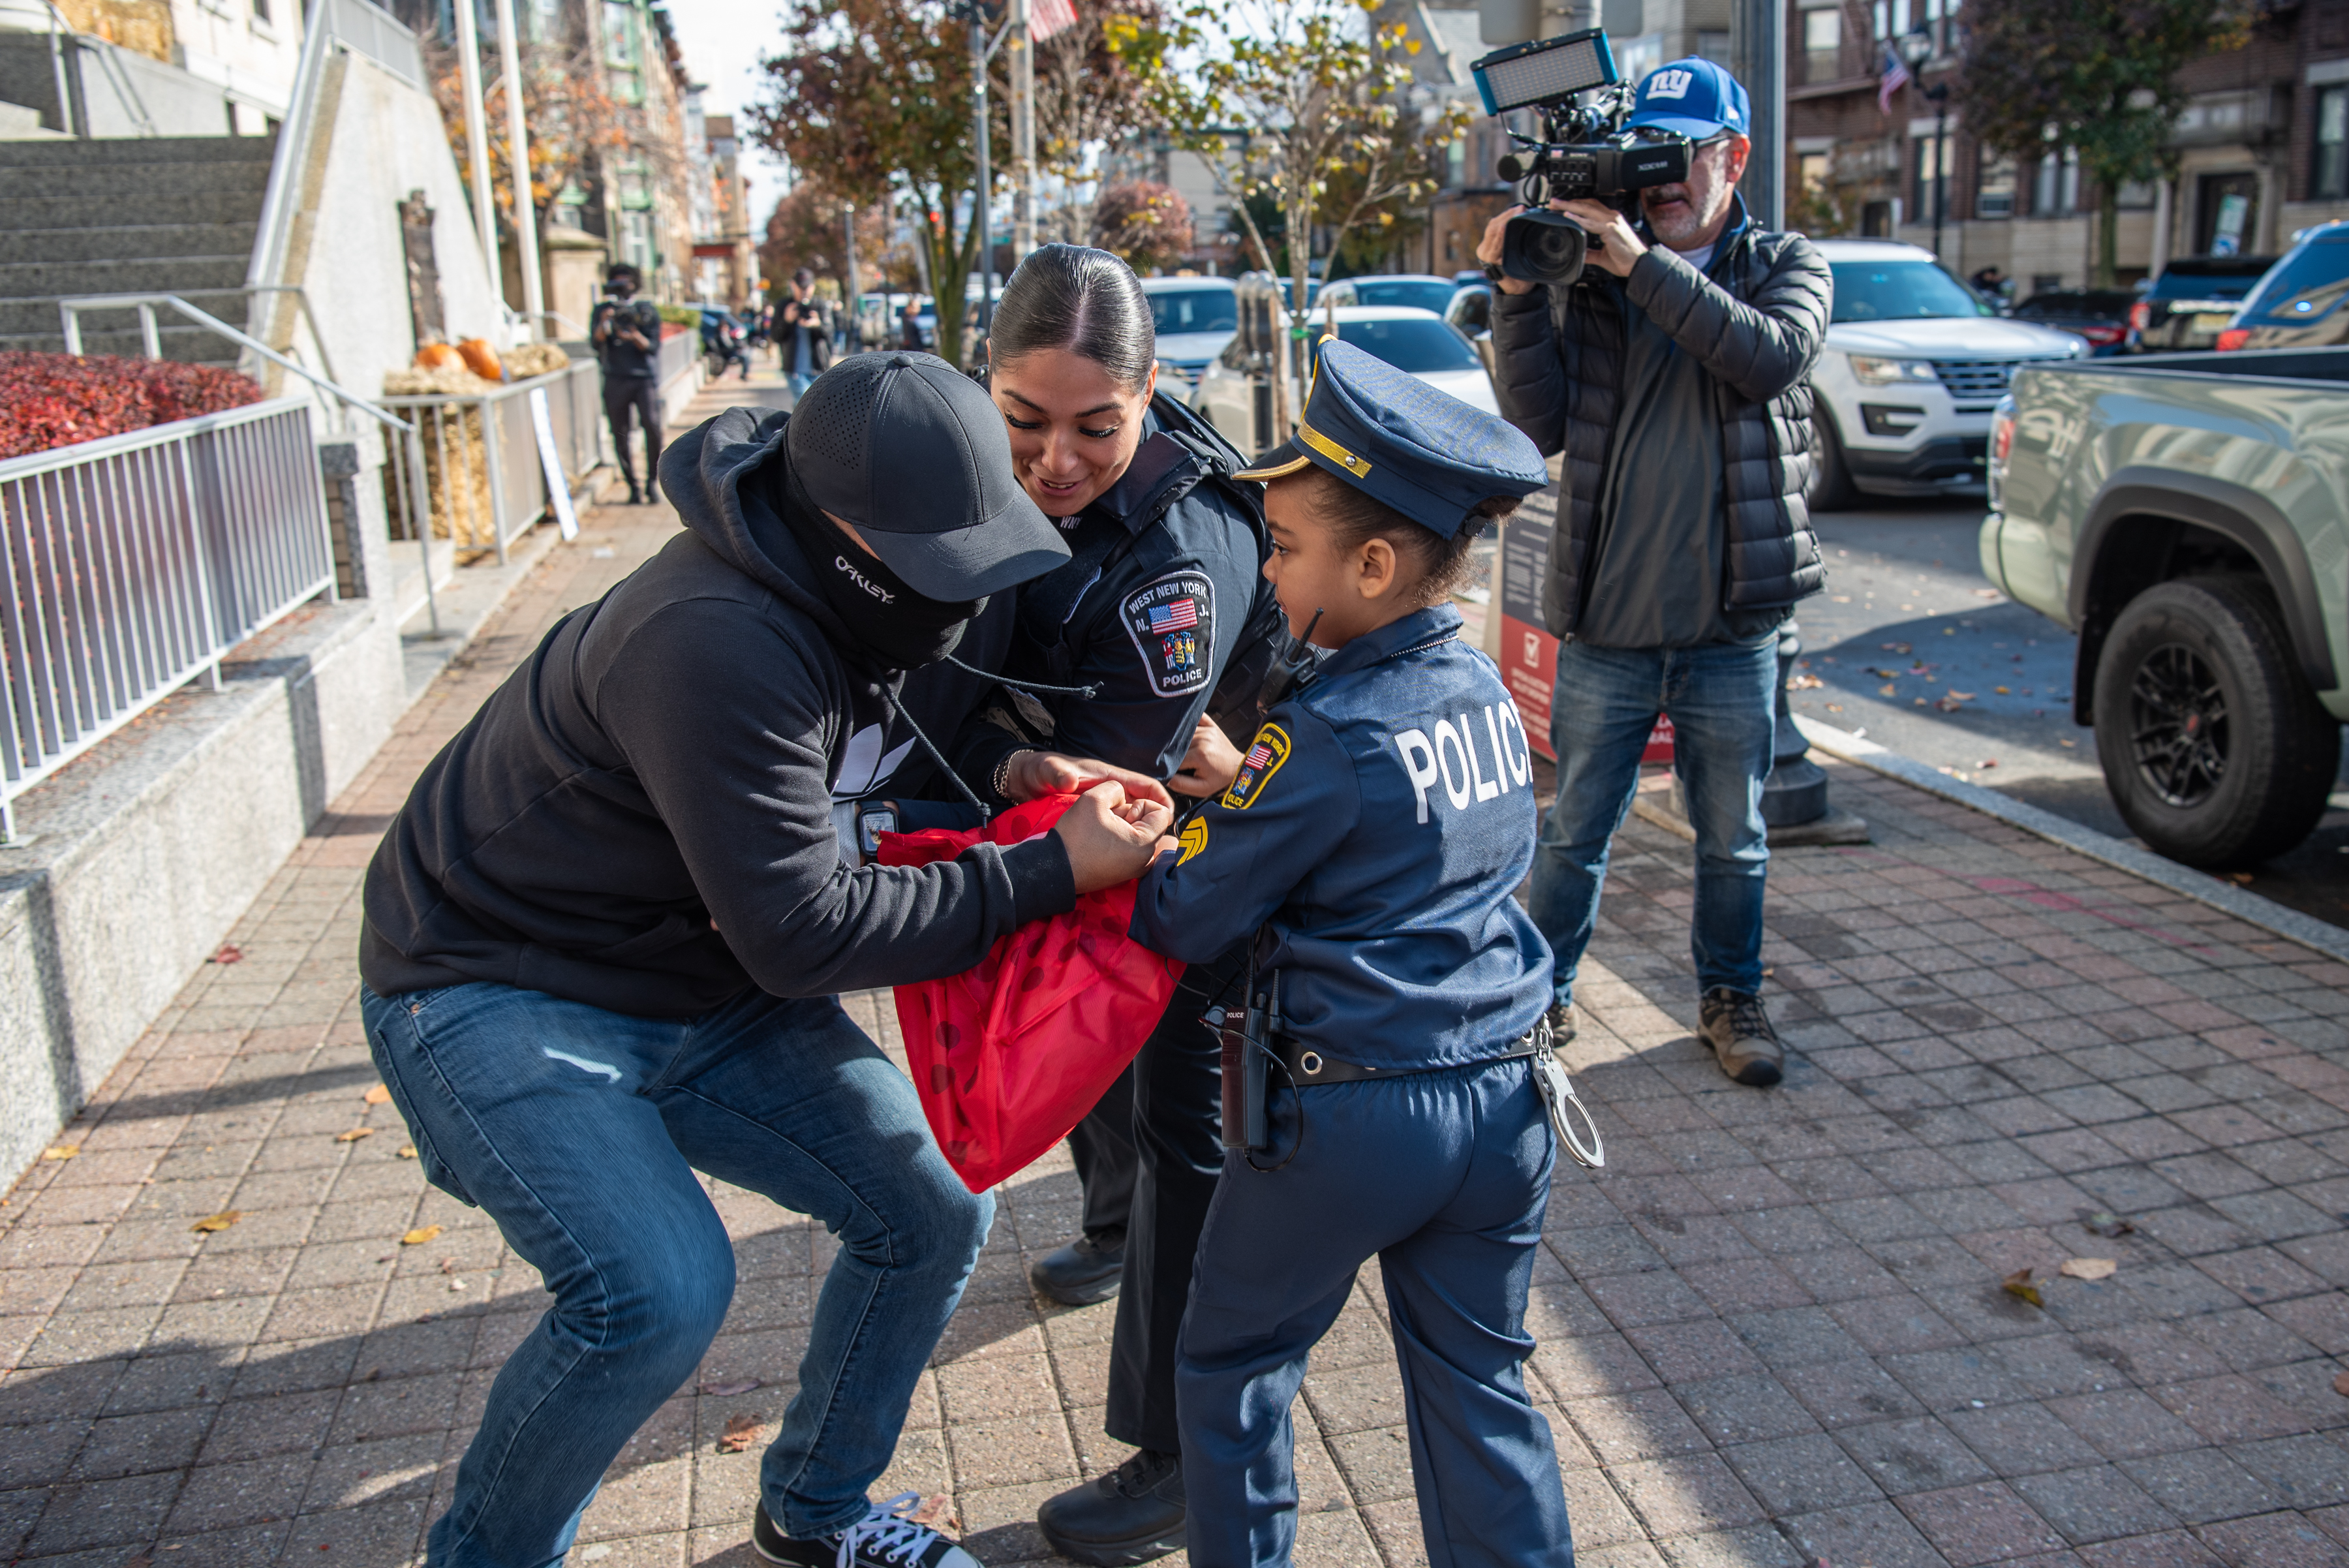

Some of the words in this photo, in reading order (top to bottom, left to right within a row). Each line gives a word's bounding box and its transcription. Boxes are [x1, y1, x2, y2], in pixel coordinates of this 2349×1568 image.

[1060, 515, 1082, 529] WNY
[835, 555, 895, 602] OAKLEY
[1129, 590, 1154, 614] WEST
[1156, 582, 1179, 599] NEW
[1181, 581, 1206, 598] YORK
[1135, 618, 1150, 633] N.
[1199, 604, 1209, 617] J.
[1163, 668, 1202, 687] POLICE
